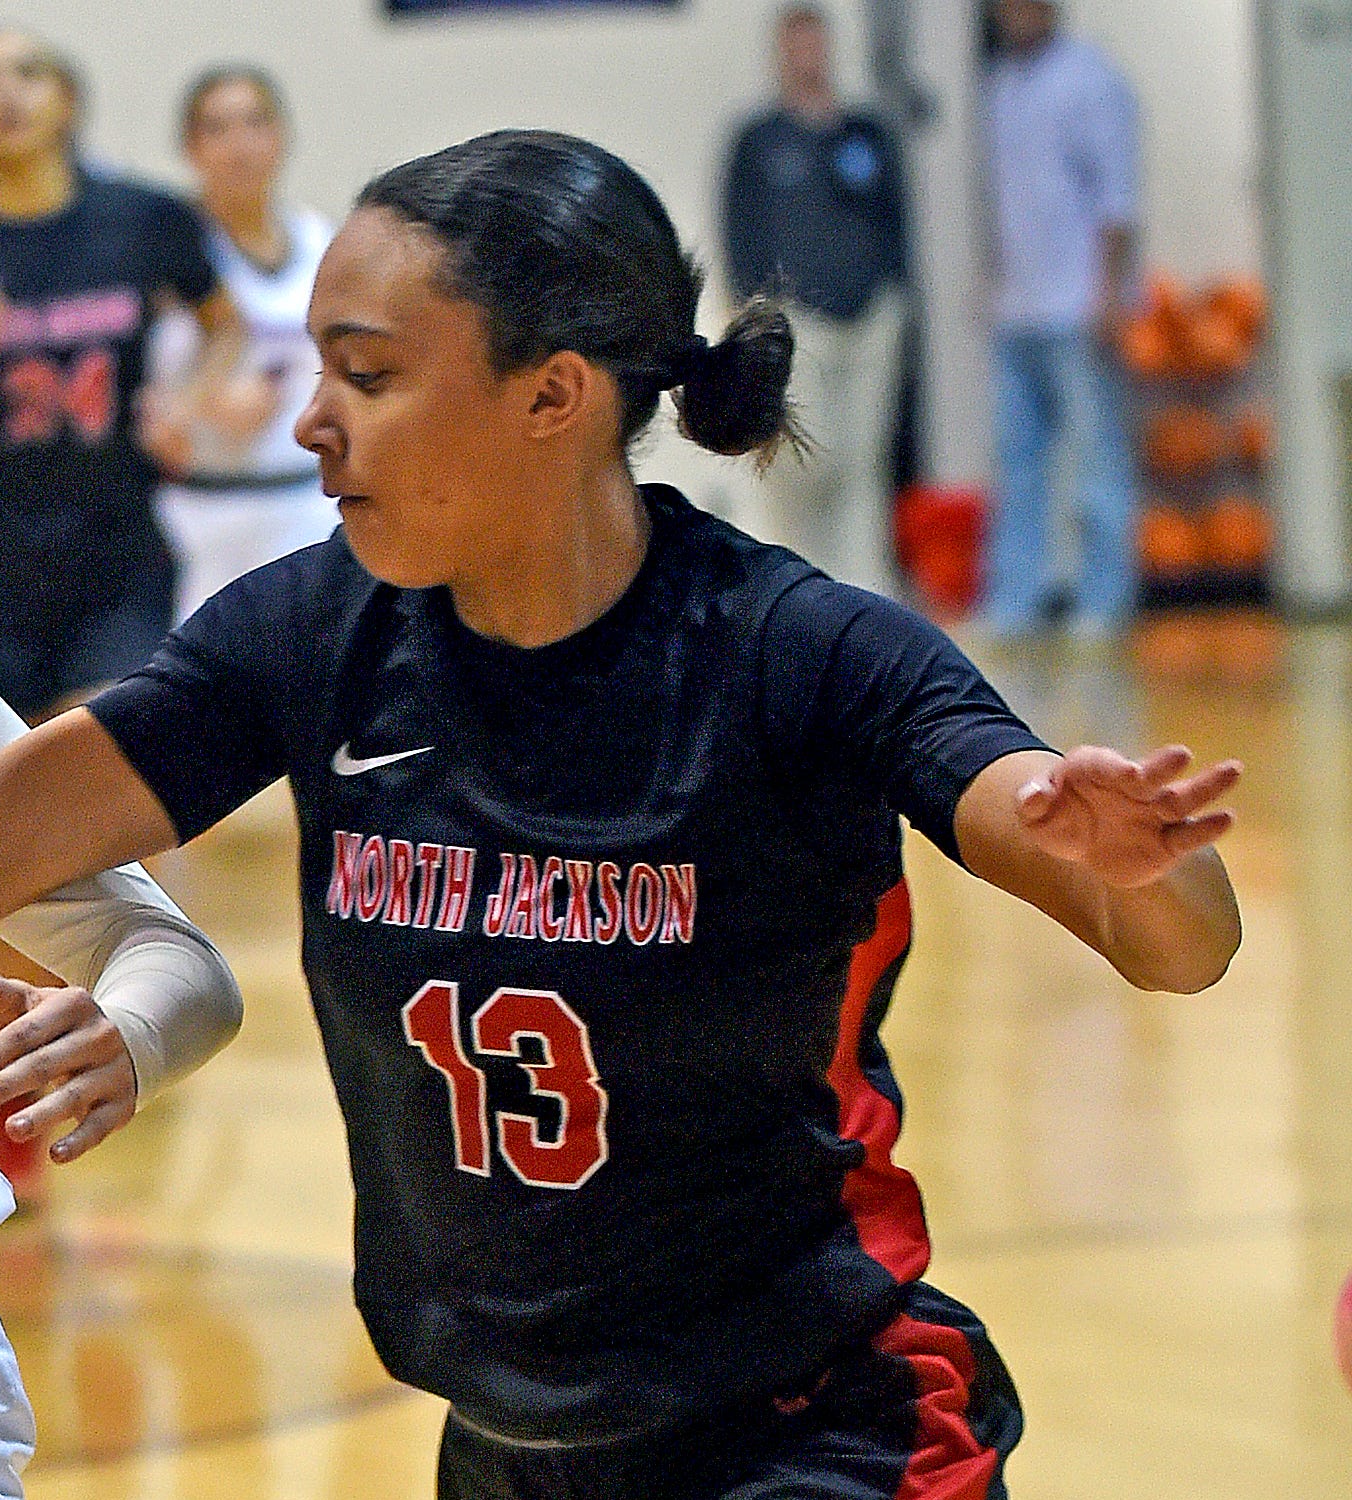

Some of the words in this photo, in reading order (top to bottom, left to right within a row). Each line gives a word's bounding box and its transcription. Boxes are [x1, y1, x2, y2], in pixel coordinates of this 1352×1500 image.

[329, 830, 477, 933] NORTH
[483, 851, 697, 946] JACKSON
[400, 978, 610, 1191] 13
